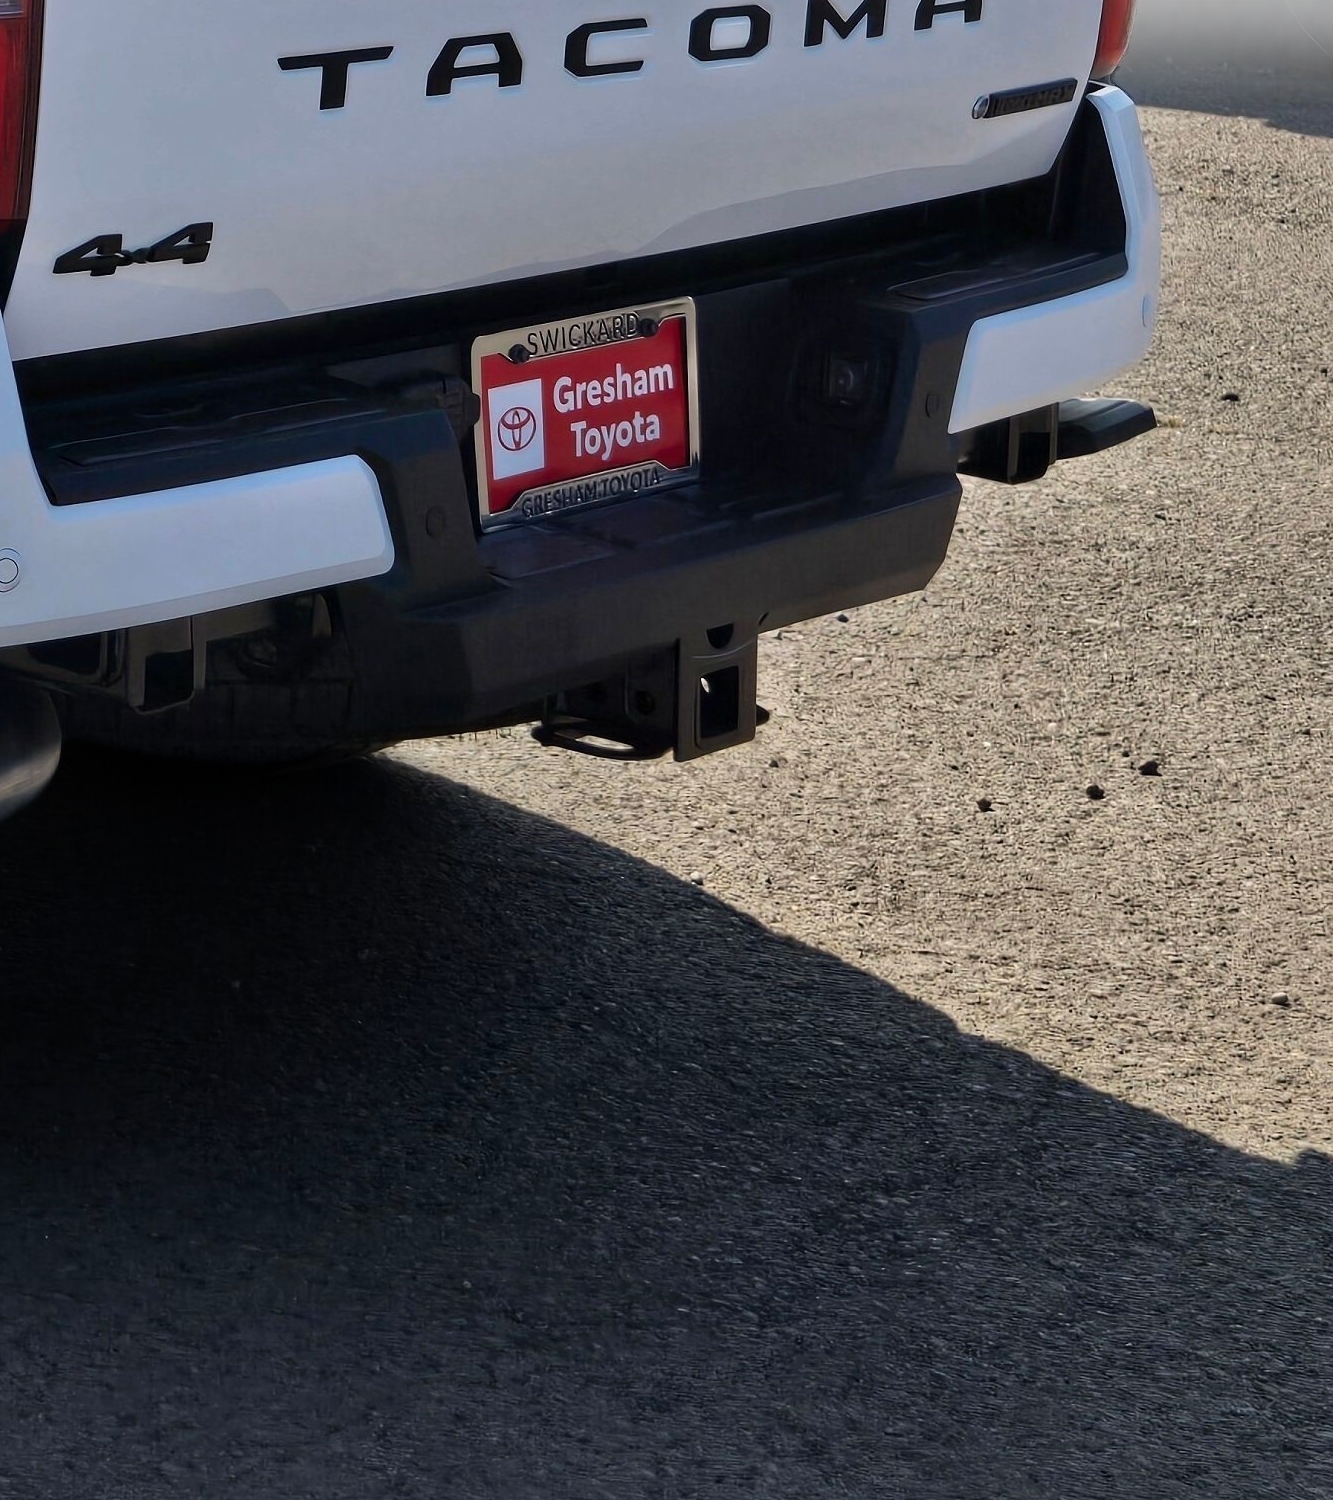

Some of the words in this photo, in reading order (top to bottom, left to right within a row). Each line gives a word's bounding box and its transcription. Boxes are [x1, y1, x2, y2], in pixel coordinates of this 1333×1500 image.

[527, 312, 639, 357] SWICKARD
[553, 362, 674, 414] Gresham
[570, 411, 660, 461] Toyota
